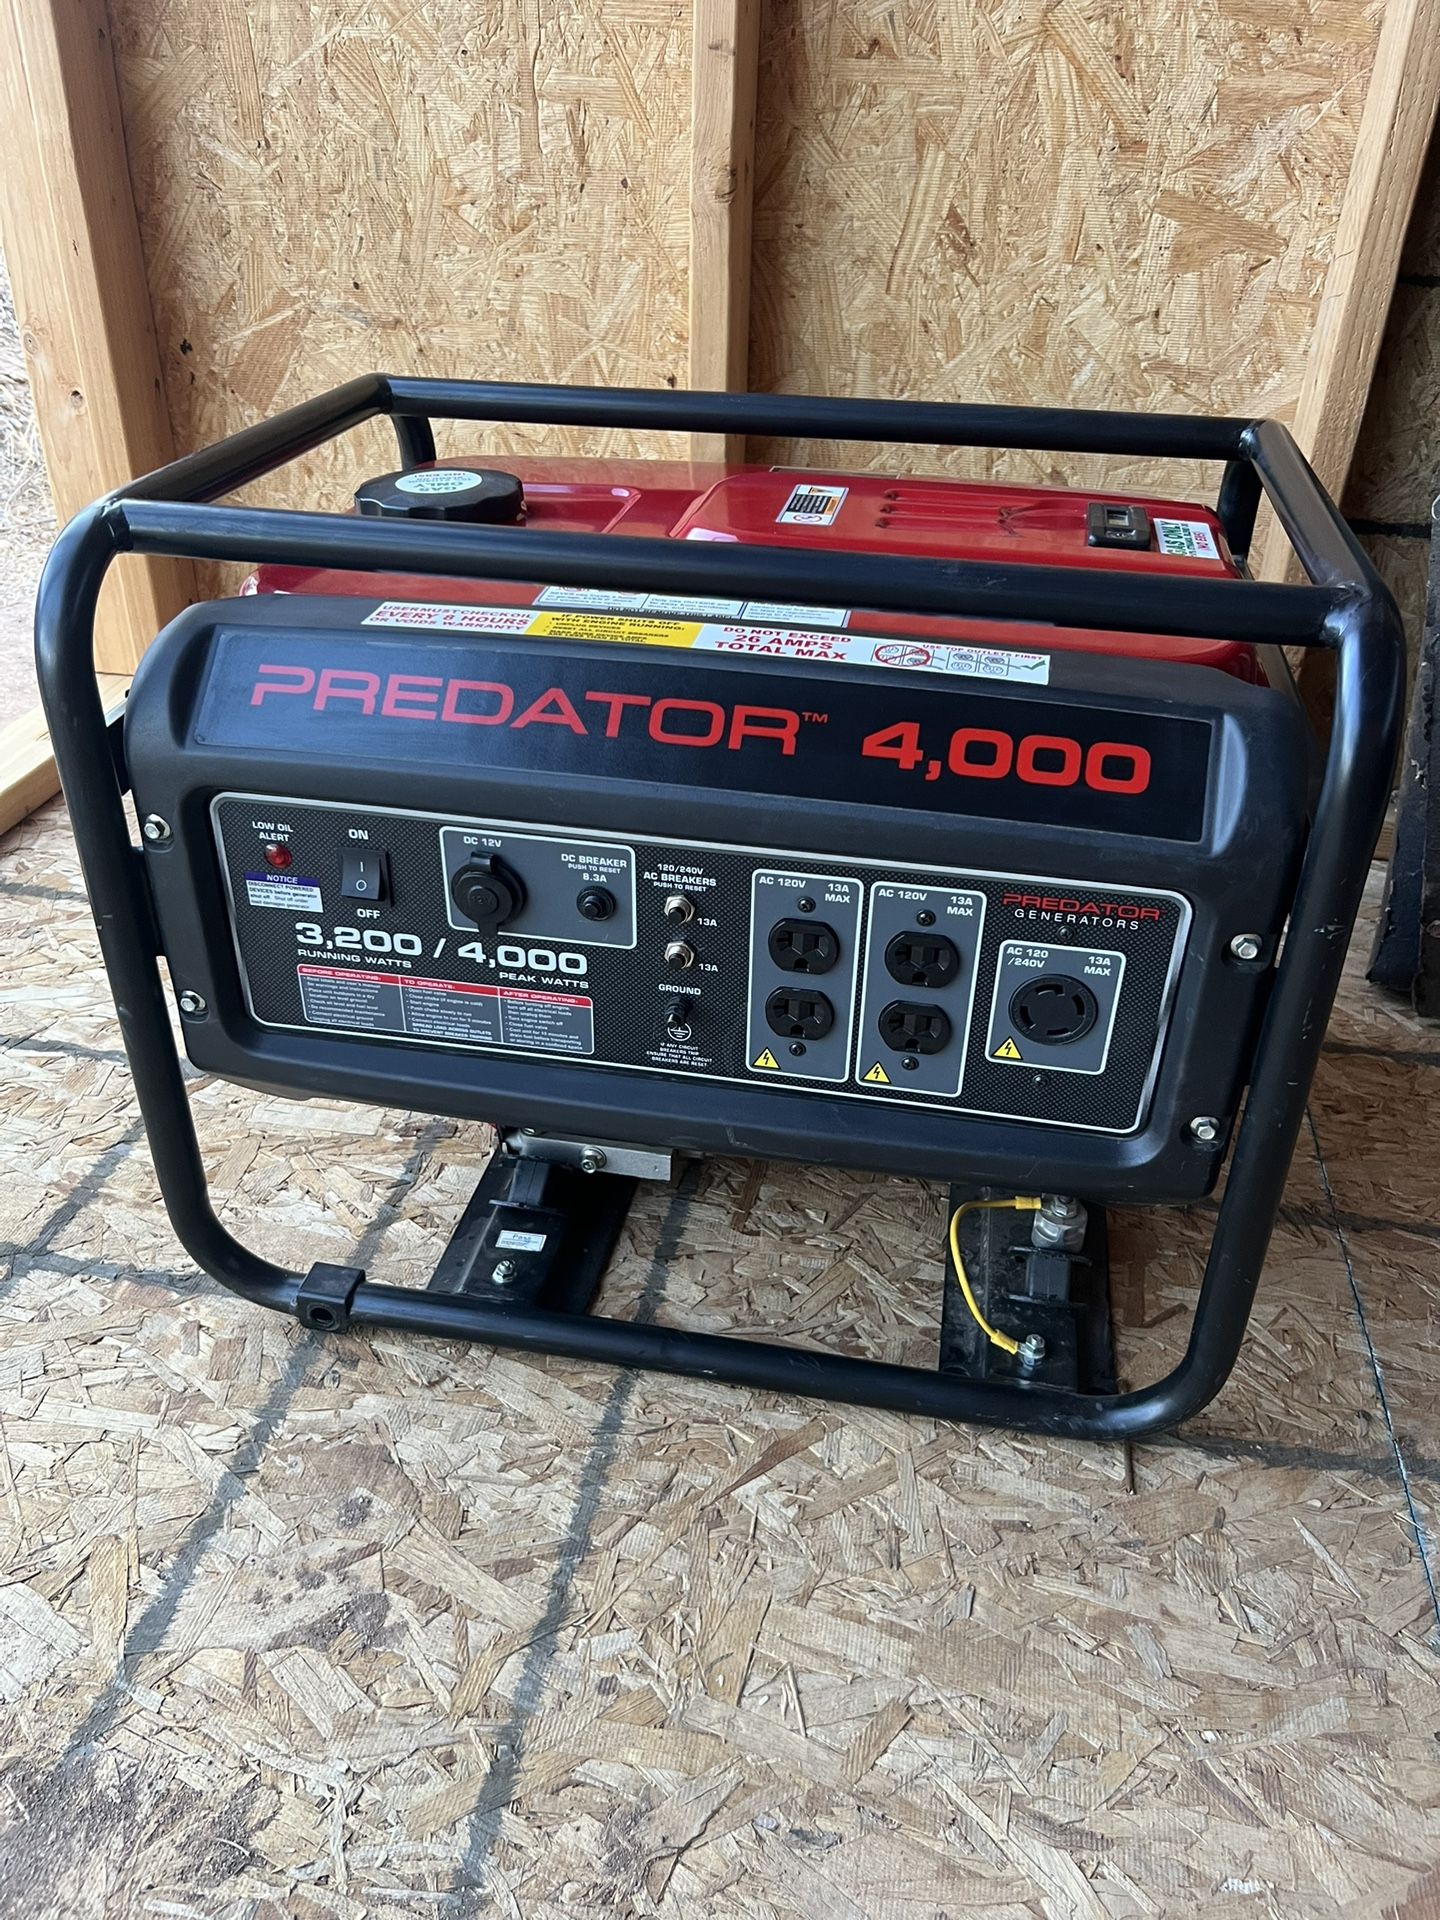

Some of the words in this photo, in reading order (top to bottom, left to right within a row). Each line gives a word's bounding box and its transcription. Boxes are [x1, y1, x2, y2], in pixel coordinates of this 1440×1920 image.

[374, 610, 437, 619] EVERY
[459, 615, 530, 625] HOURS
[440, 621, 524, 630] WARRANTY
[750, 628, 783, 636] NOT
[787, 632, 851, 643] EXCEED
[733, 634, 762, 643] 26
[767, 636, 834, 650] AMPS
[712, 640, 788, 654] TOTAL
[794, 648, 847, 660] MAX
[967, 648, 1011, 656] OUTLETS
[861, 721, 1151, 795] 4,000
[252, 821, 274, 830] LOW
[278, 823, 293, 832] OIL
[259, 832, 289, 842] ALERT
[349, 829, 368, 840] ON
[464, 836, 478, 845] DC
[482, 838, 502, 847] 12V
[561, 853, 576, 862] DC
[579, 855, 627, 868] BREAKER
[599, 866, 621, 874] RESET
[657, 863, 703, 875] 120/240V
[267, 874, 298, 884] NOTICE
[583, 873, 607, 883] 8.3A
[644, 872, 658, 880] AC
[661, 873, 716, 887] BREAKERS
[759, 876, 774, 885] AC
[778, 878, 806, 889] 120V
[685, 884, 707, 892] RESET
[828, 884, 849, 893] 13A
[825, 894, 850, 903] MAX
[879, 888, 894, 897] AC
[898, 890, 927, 901] 120V
[950, 896, 973, 906] 13A
[947, 907, 973, 916] MAX
[1002, 894, 1161, 921] PREDATOR
[357, 908, 380, 919] OFF
[1014, 908, 1139, 930] GENERATORS
[697, 918, 717, 927] 13A
[296, 922, 422, 956] 3,200
[433, 938, 446, 958] /
[458, 942, 588, 974] 4,000
[1006, 947, 1023, 955] AC
[1026, 948, 1049, 958] 120
[298, 949, 361, 963] RUNNING
[365, 956, 412, 968] WATTS
[1008, 957, 1045, 968] /240V
[1088, 956, 1111, 966] 13A
[301, 967, 332, 975] BEFORE
[699, 963, 718, 972] 13A
[1084, 965, 1111, 976] MAX
[500, 972, 536, 982] PEAK
[541, 976, 589, 988] WATTS
[503, 990, 528, 998] AFTER
[659, 984, 701, 995] GROUND
